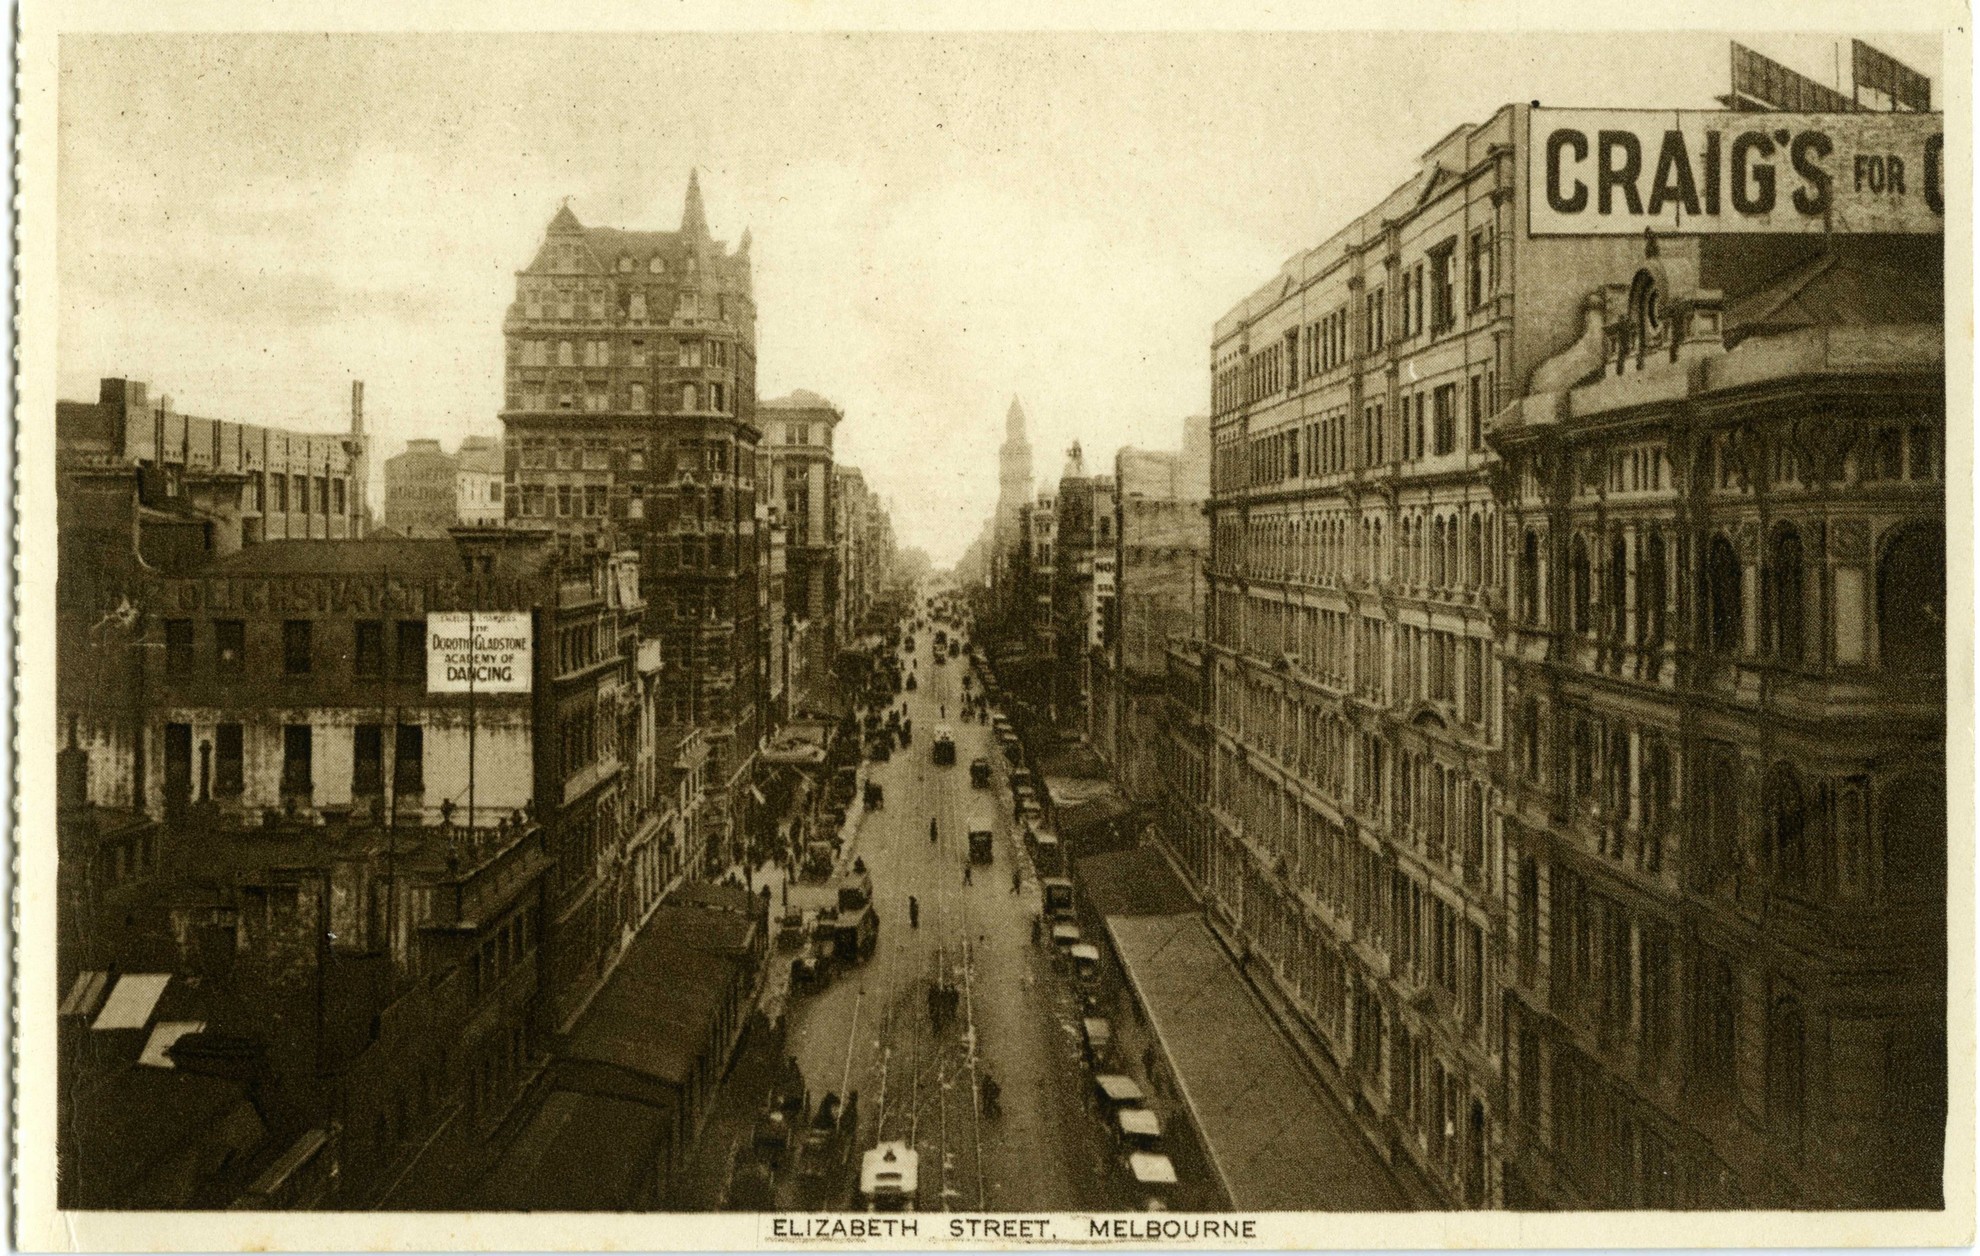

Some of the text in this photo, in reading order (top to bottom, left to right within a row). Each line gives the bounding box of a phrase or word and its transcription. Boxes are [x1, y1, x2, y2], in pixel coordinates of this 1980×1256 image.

[1546, 128, 1833, 216] CRAIG'S
[1853, 154, 1905, 195] FOR
[475, 634, 526, 651] GLADSTONE
[444, 653, 514, 664] ACADEMY OF
